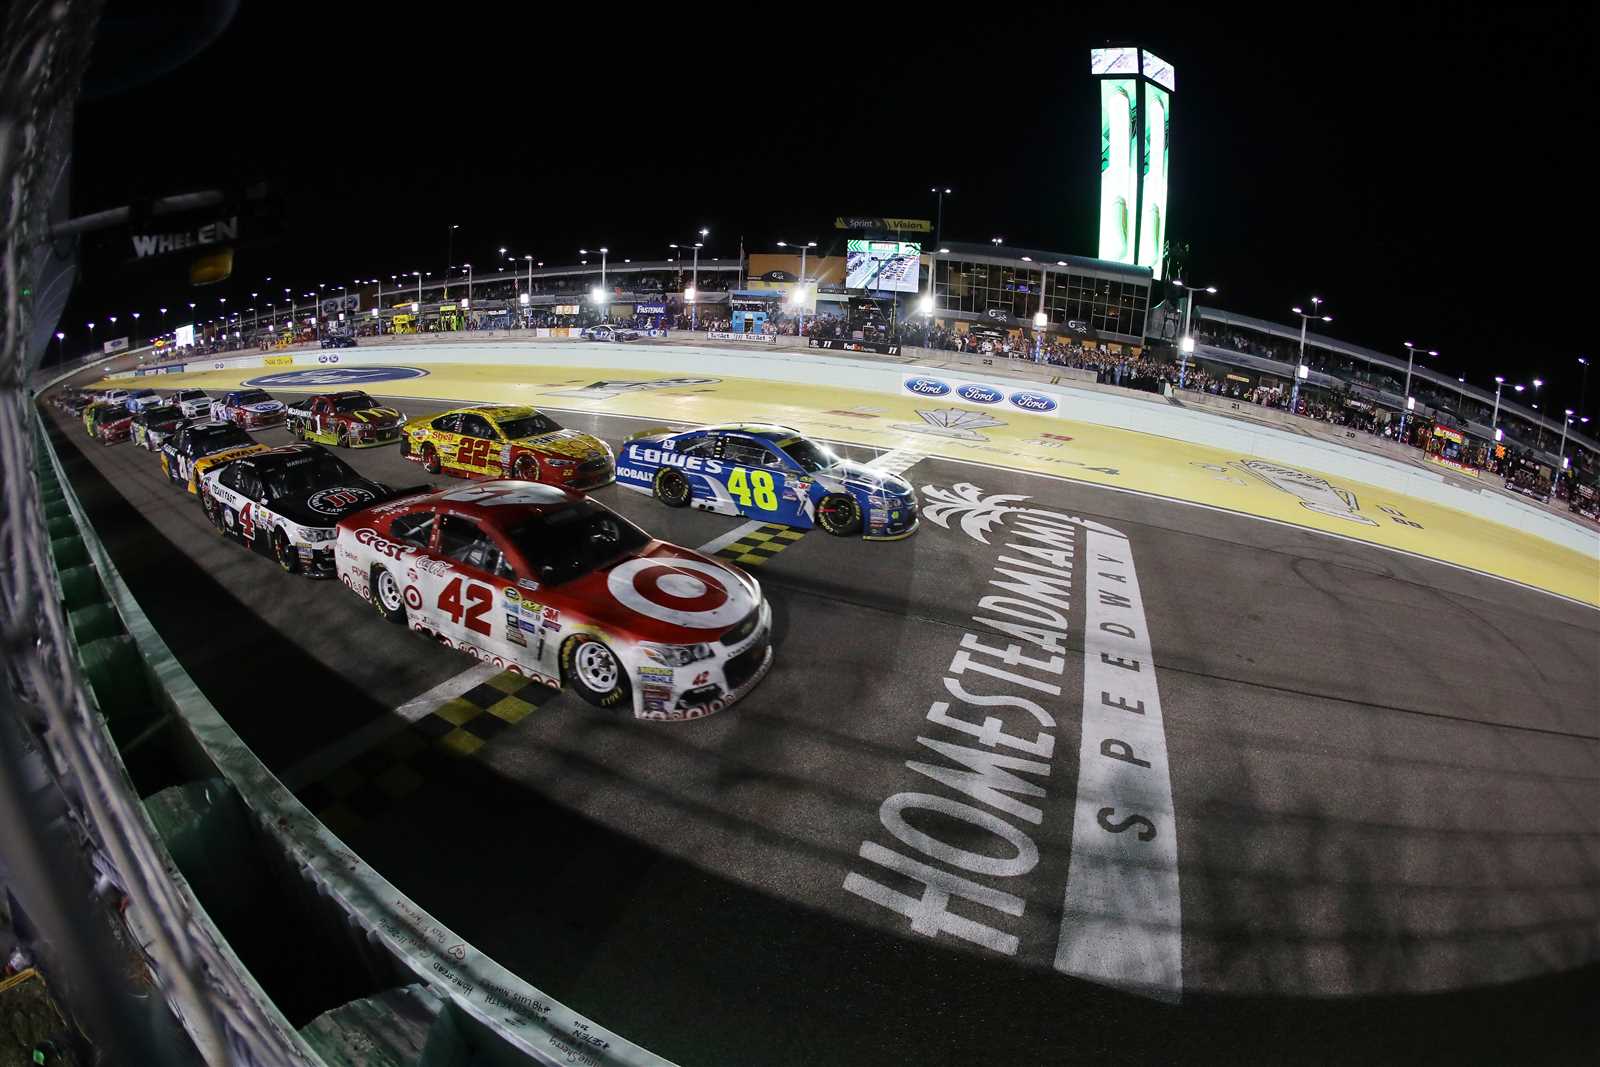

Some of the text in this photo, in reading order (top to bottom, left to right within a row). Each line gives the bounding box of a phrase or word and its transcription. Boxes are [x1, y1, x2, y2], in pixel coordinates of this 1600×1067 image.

[849, 219, 872, 229] Sprint
[913, 378, 942, 394] Ford
[965, 386, 994, 402] Ford
[1018, 394, 1048, 410] Ford
[432, 431, 454, 441] Shell
[456, 437, 491, 467] 22
[616, 466, 655, 482] KOBALT
[727, 467, 778, 511] 48
[239, 502, 255, 540] 4
[355, 528, 417, 561] Crest
[437, 576, 494, 638] 42
[1097, 554, 1158, 842] SPEEDWAY
